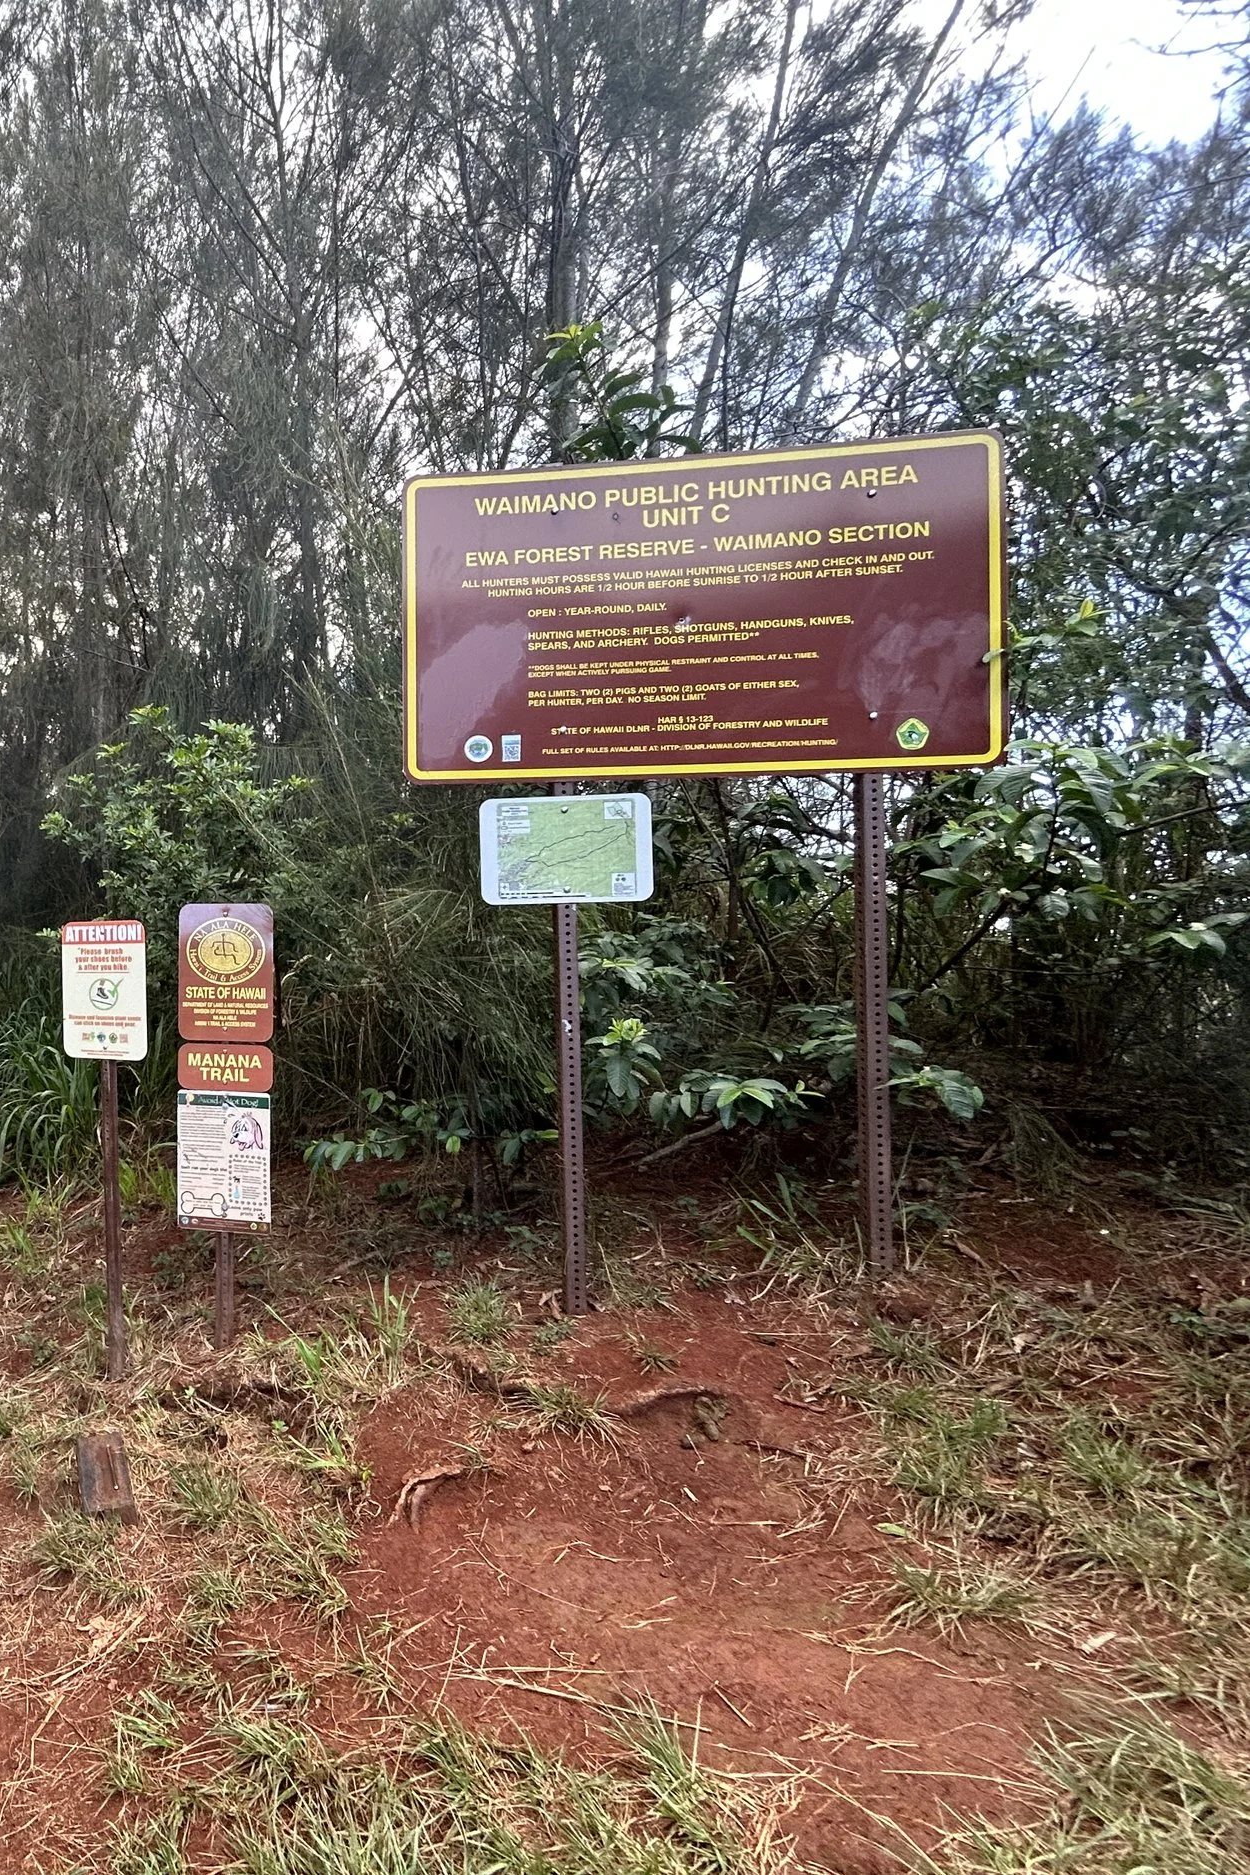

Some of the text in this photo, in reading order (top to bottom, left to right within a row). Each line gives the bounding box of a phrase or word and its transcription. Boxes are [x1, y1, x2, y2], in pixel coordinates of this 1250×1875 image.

[475, 464, 917, 515] WAIMANO PUBLIC HUNTING AREA
[642, 503, 730, 528] UNIT C
[465, 550, 508, 567] EWA
[514, 545, 593, 564] FOREST
[599, 538, 694, 559] RESERVE
[713, 529, 821, 551] WAIMANO
[828, 521, 929, 543] SECTION
[461, 550, 935, 588] ALL HUNTERS MUST POSSESS VALID HAWAII HUNTING LICENSES AND CHECK IN AND OUT.
[487, 563, 903, 597] HUNTING HOURS ARE 1/2 HOUR BEFORE SUNRISE TO 1/2 HOUR AFTER SUNSET.
[527, 608, 556, 617] OPEN
[564, 604, 634, 615] YEAR-ROUND,
[636, 602, 667, 612] DAILY.
[527, 614, 854, 640] HUNTING METHODS: RIFLES, SHOTGUNS, HANDGUNS, KNIVES,
[527, 640, 571, 650] SPEARS,
[572, 639, 595, 649] AND
[597, 637, 648, 647] ARCHERY.
[653, 635, 685, 645] DOGS
[527, 690, 546, 698] BAG
[547, 689, 578, 697] LIMITS:
[579, 688, 600, 696] TWO
[601, 688, 613, 697] (2)
[615, 686, 636, 695] PIGS
[637, 685, 657, 694] AND
[658, 684, 680, 693] TWO
[681, 684, 693, 693] (2)
[694, 682, 726, 692] GOATS
[727, 682, 741, 690] OF
[742, 680, 776, 689] EITHER
[527, 692, 706, 707] PER HUNTER, PER DAY. NO SEASON LIMIT.
[578, 726, 591, 734] OF
[593, 725, 624, 734] HAWAII
[625, 724, 650, 733] DLNR
[656, 722, 696, 731] DIVISION
[697, 722, 711, 730] OF
[712, 720, 760, 729] FORESTRY
[761, 719, 783, 727] AND
[784, 717, 828, 726] WILDLIFE
[657, 716, 677, 724] HAR
[685, 714, 714, 723] 13-123
[65, 924, 142, 942] ATTENTION!
[211, 921, 229, 931] ALA
[233, 922, 257, 942] HELE
[185, 986, 266, 1000] STATE OF HAWAII
[188, 1053, 262, 1069] MANANA
[199, 1067, 250, 1083] TRAIL
